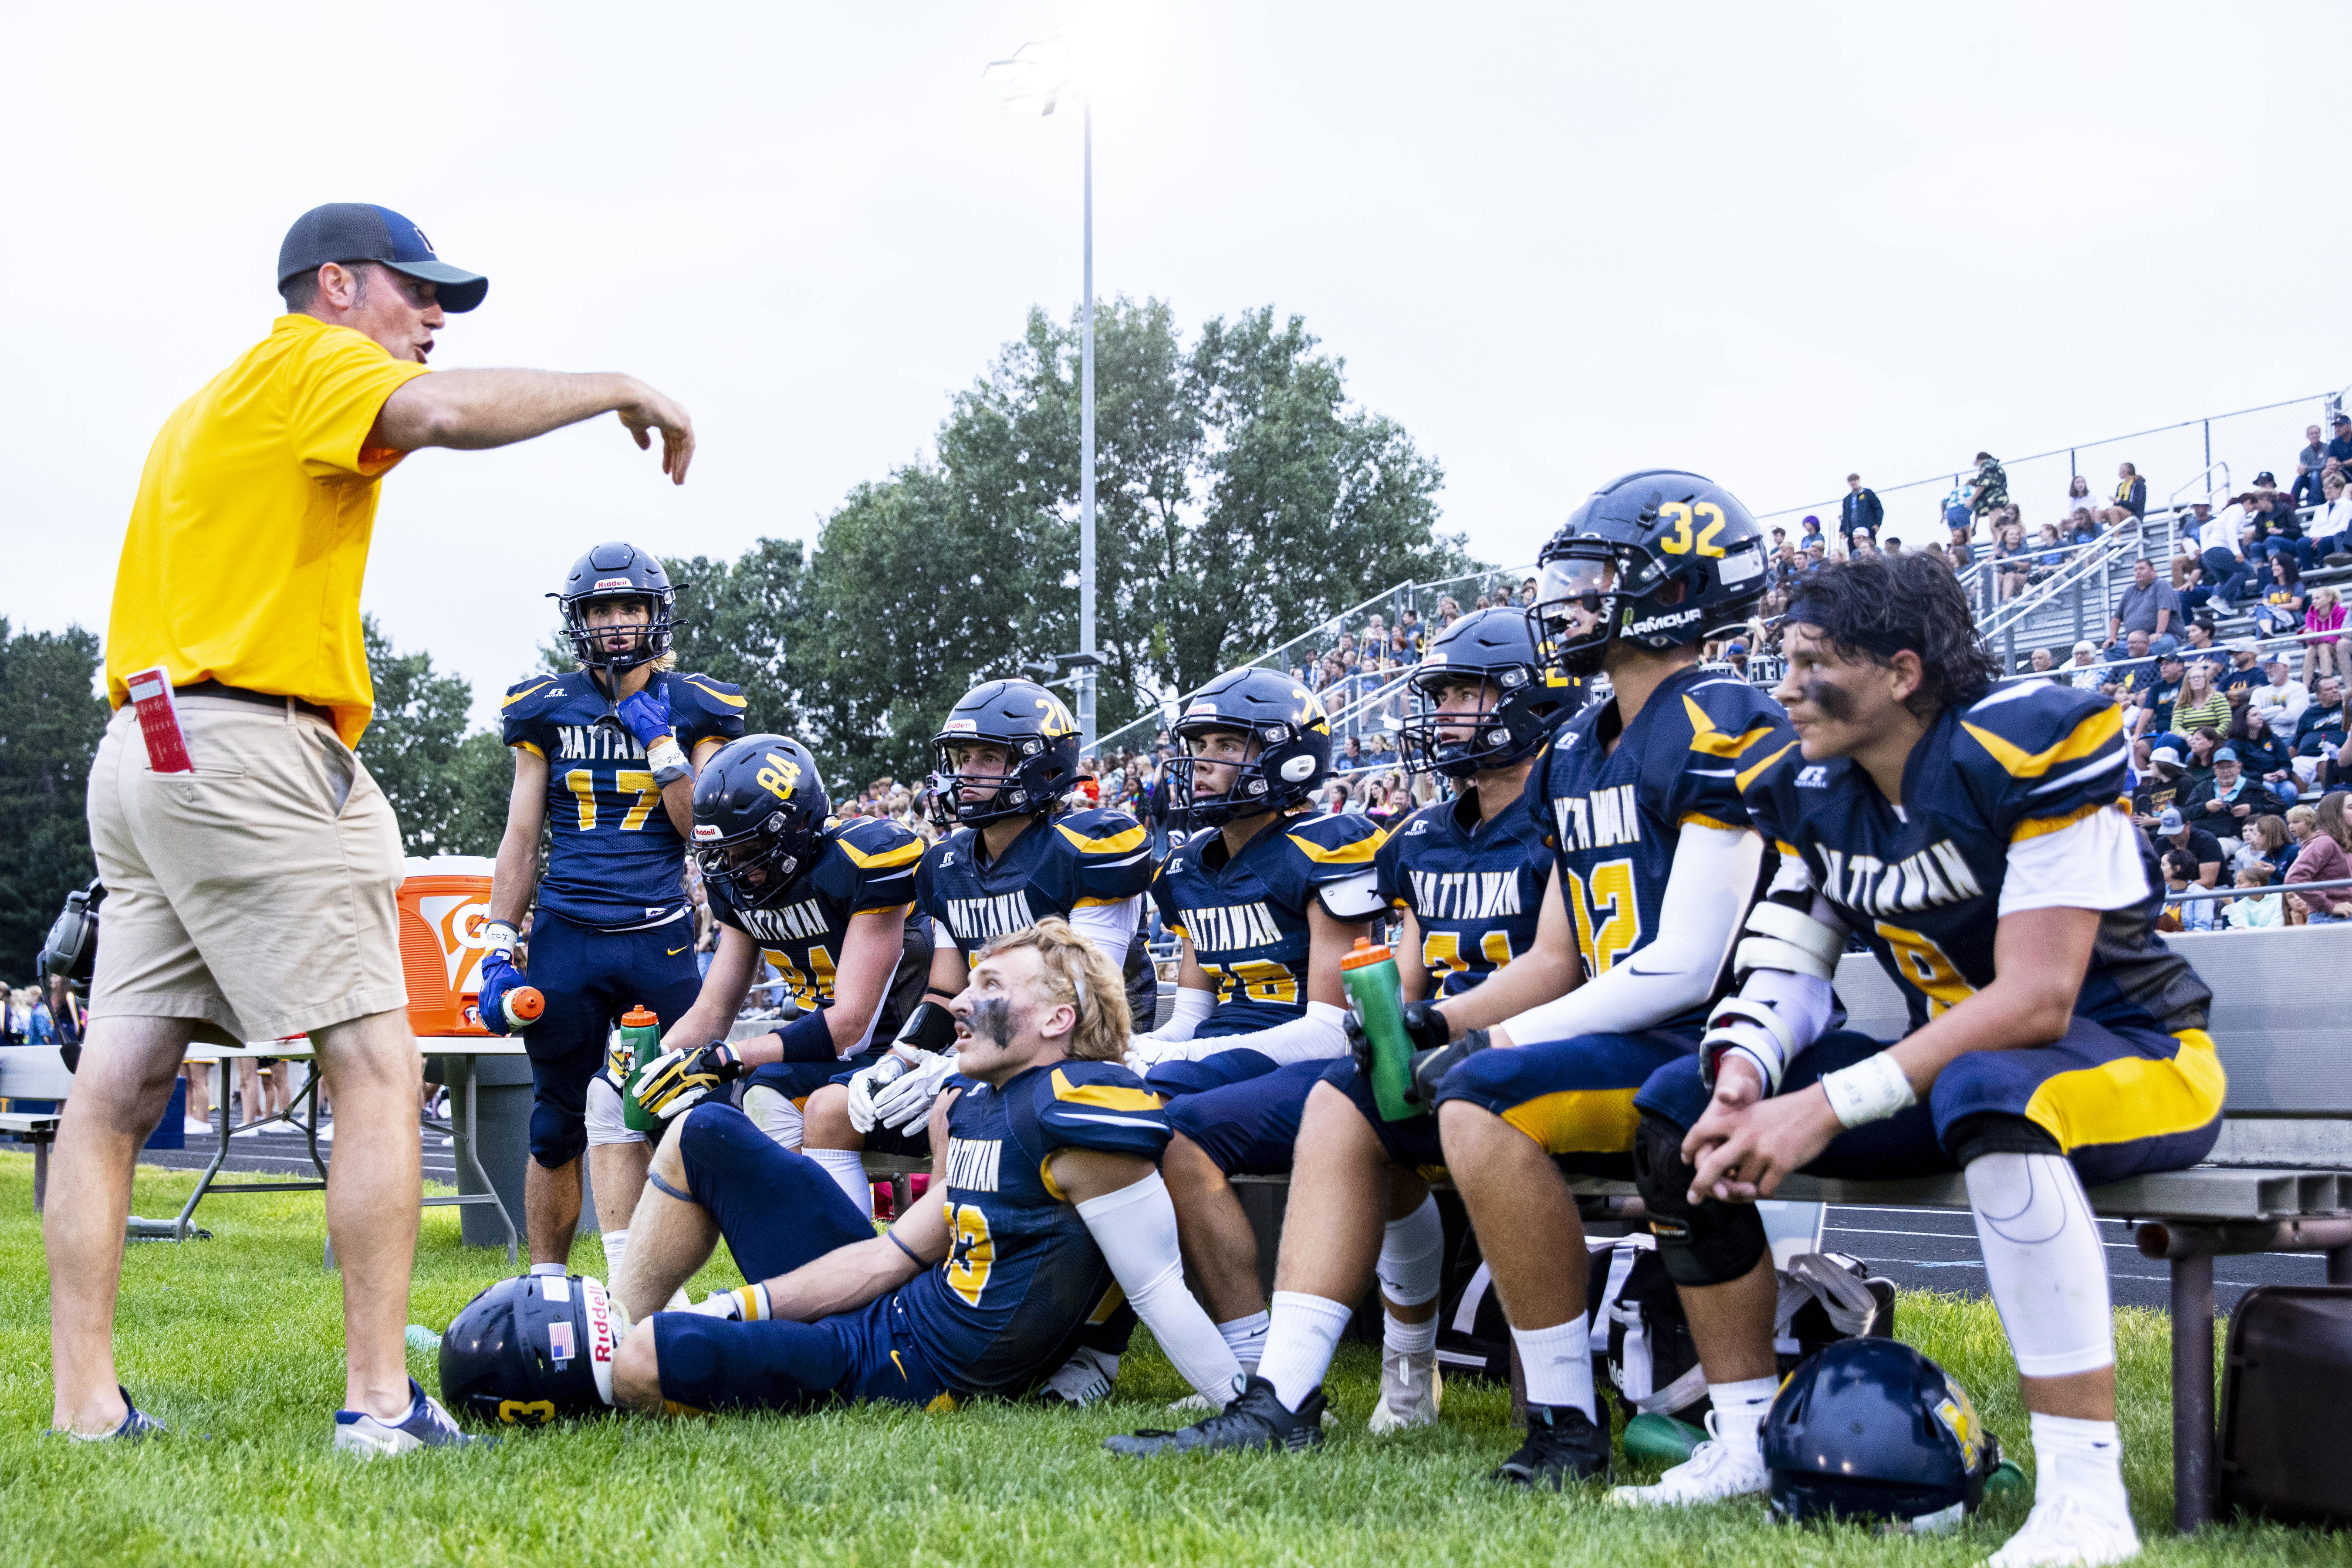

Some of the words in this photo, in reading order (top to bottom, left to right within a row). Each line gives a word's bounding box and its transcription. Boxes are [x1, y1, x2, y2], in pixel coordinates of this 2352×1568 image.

[1659, 502, 1726, 558] 32
[1620, 608, 1702, 638] ARMOUR
[557, 725, 676, 759] MATTAW
[1035, 699, 1073, 740] 20
[565, 768, 661, 831] 17
[756, 753, 801, 800] 84
[1166, 867, 1183, 875] RUSSELL
[1409, 866, 1521, 919] MATTAWAN
[452, 902, 491, 949] G
[733, 898, 829, 940] MATTAWAN
[947, 889, 1035, 938] MATTAWAN
[588, 1285, 611, 1362] Riddell
